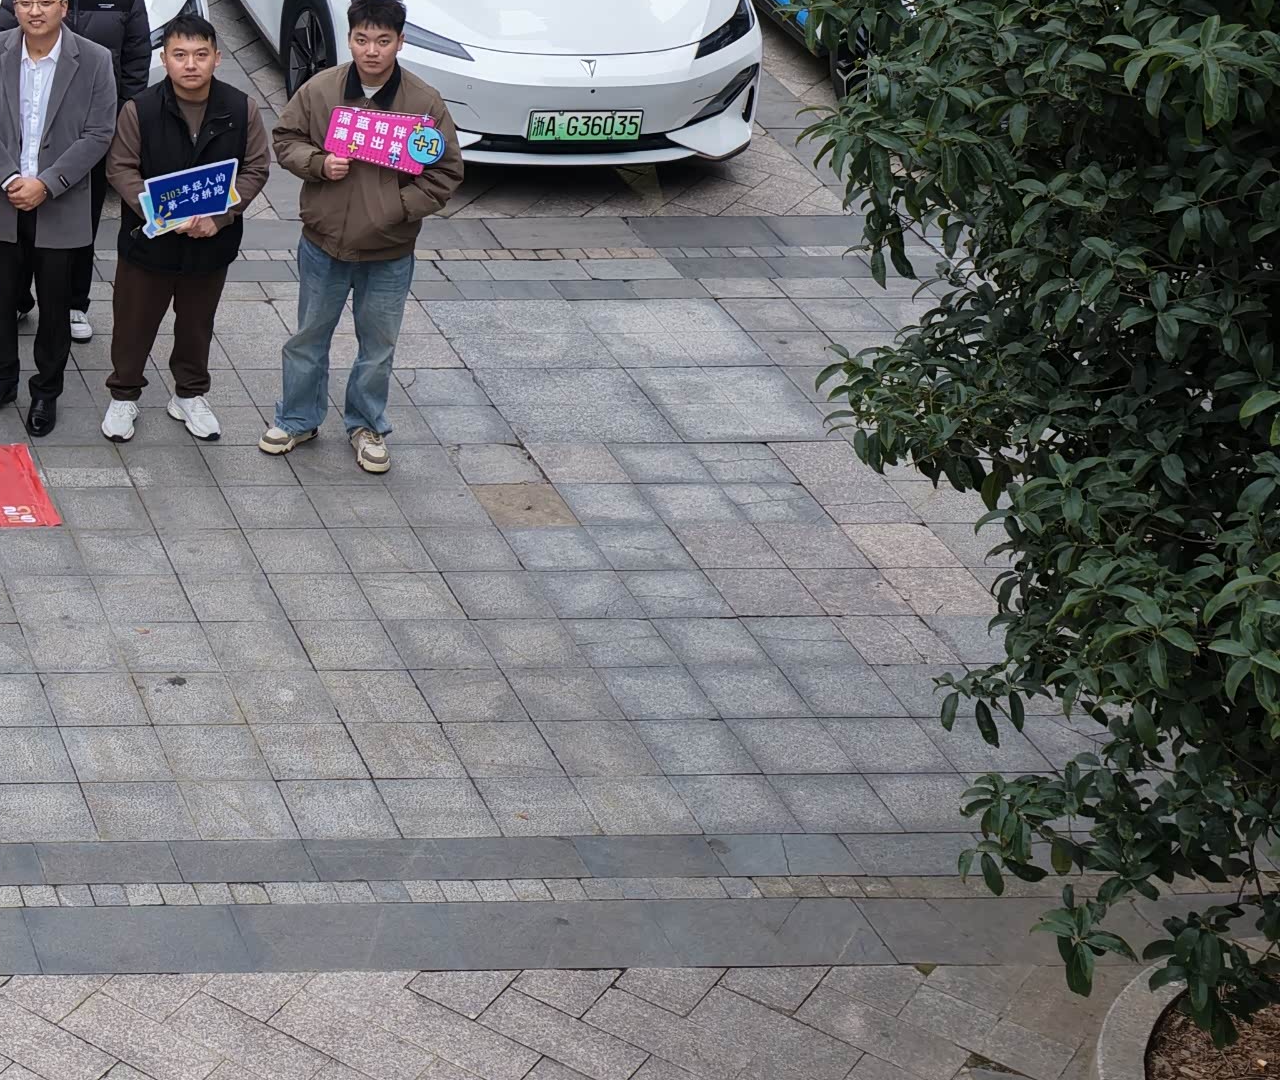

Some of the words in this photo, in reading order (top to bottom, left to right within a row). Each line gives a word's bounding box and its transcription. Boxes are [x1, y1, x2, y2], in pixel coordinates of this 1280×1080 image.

[337, 110, 407, 140] 深蓝相伴
[566, 115, 640, 137] G36035
[333, 126, 403, 155] 满电出发
[167, 184, 225, 211] 第一台轿跑
